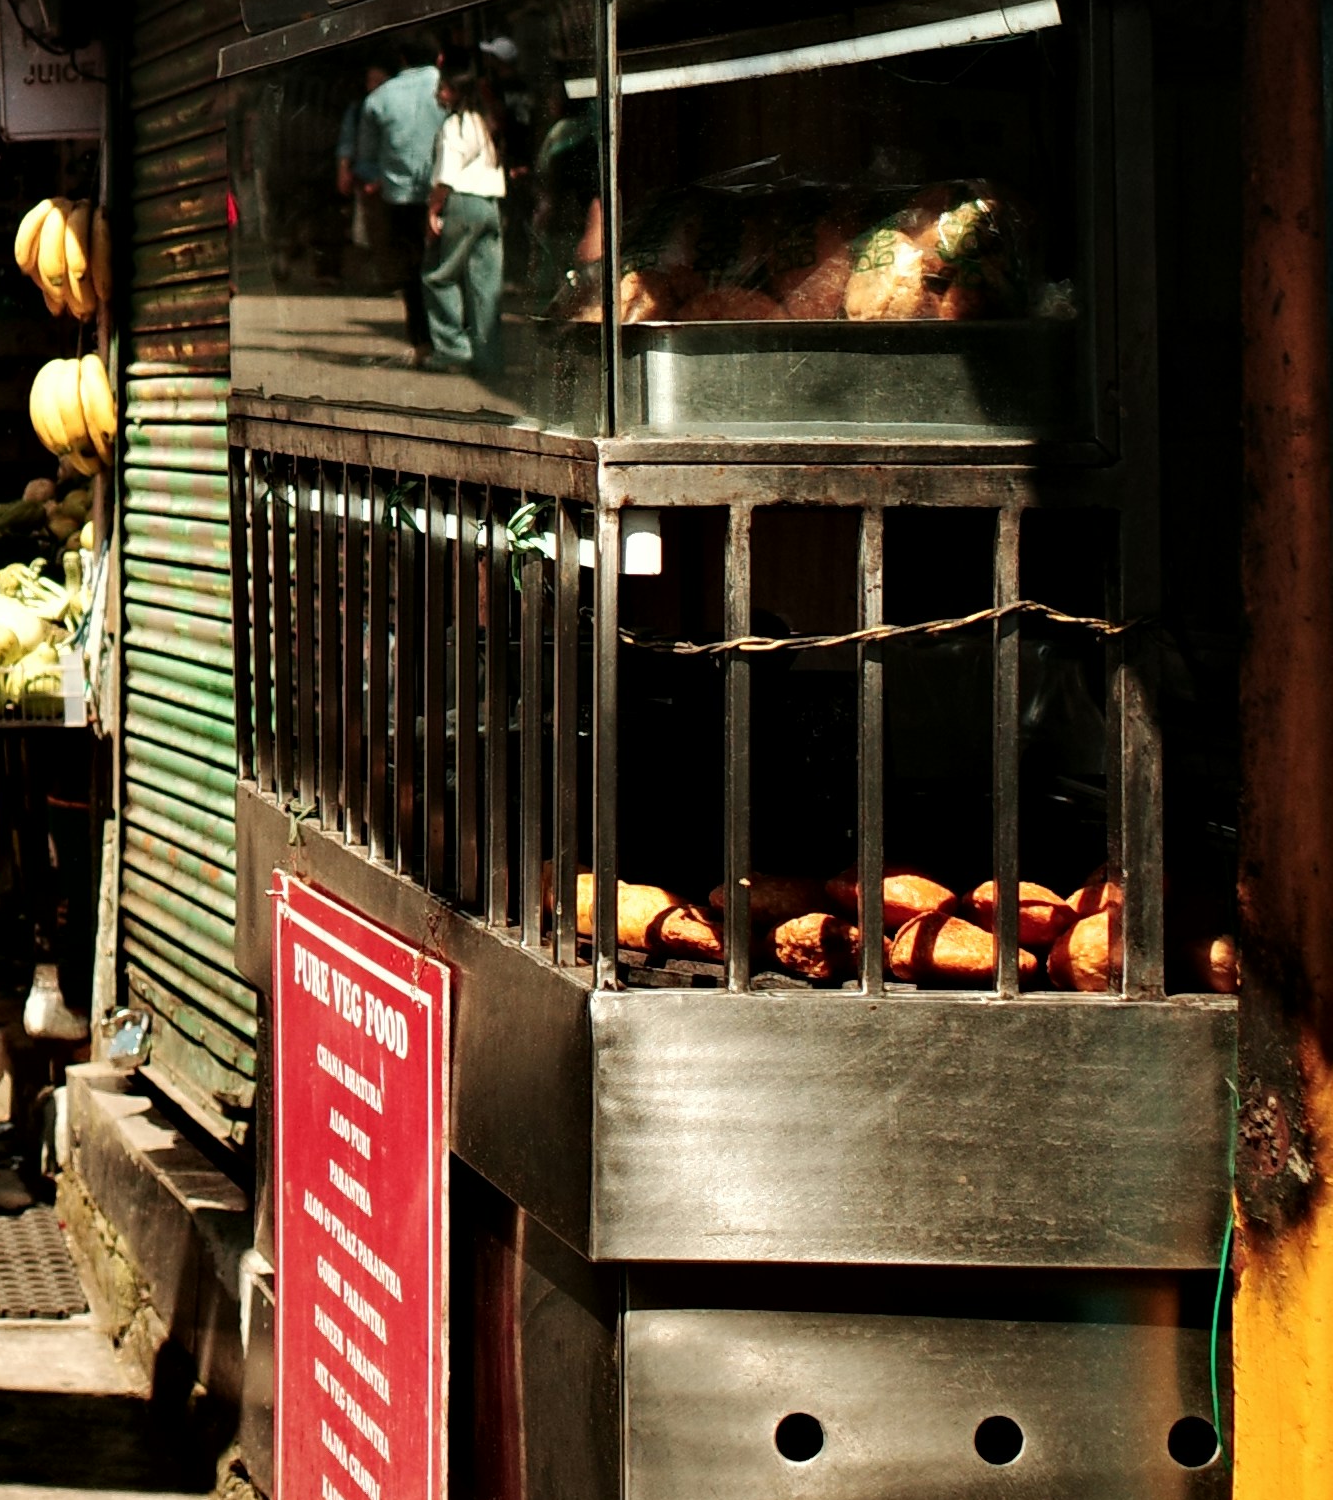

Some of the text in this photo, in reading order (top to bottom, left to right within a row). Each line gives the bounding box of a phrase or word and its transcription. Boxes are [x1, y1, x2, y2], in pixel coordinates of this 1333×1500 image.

[23, 60, 96, 86] JUICE
[293, 942, 408, 1063] PURE VEG FOOD
[316, 1042, 382, 1116] CHANA BHATURA
[329, 1105, 370, 1163] ALOO PURI
[329, 1158, 372, 1220] PARANTHA
[303, 1187, 323, 1228] ALOO
[331, 1212, 357, 1260] PYAAZ
[357, 1237, 402, 1304] PARANTHA
[317, 1252, 386, 1347] GOBHI PARANTHA
[314, 1302, 390, 1407] PANEER PARANTHA
[321, 1417, 348, 1473] RAJMA
[329, 1373, 346, 1415] VEG
[346, 1391, 389, 1465] PARANTHA
